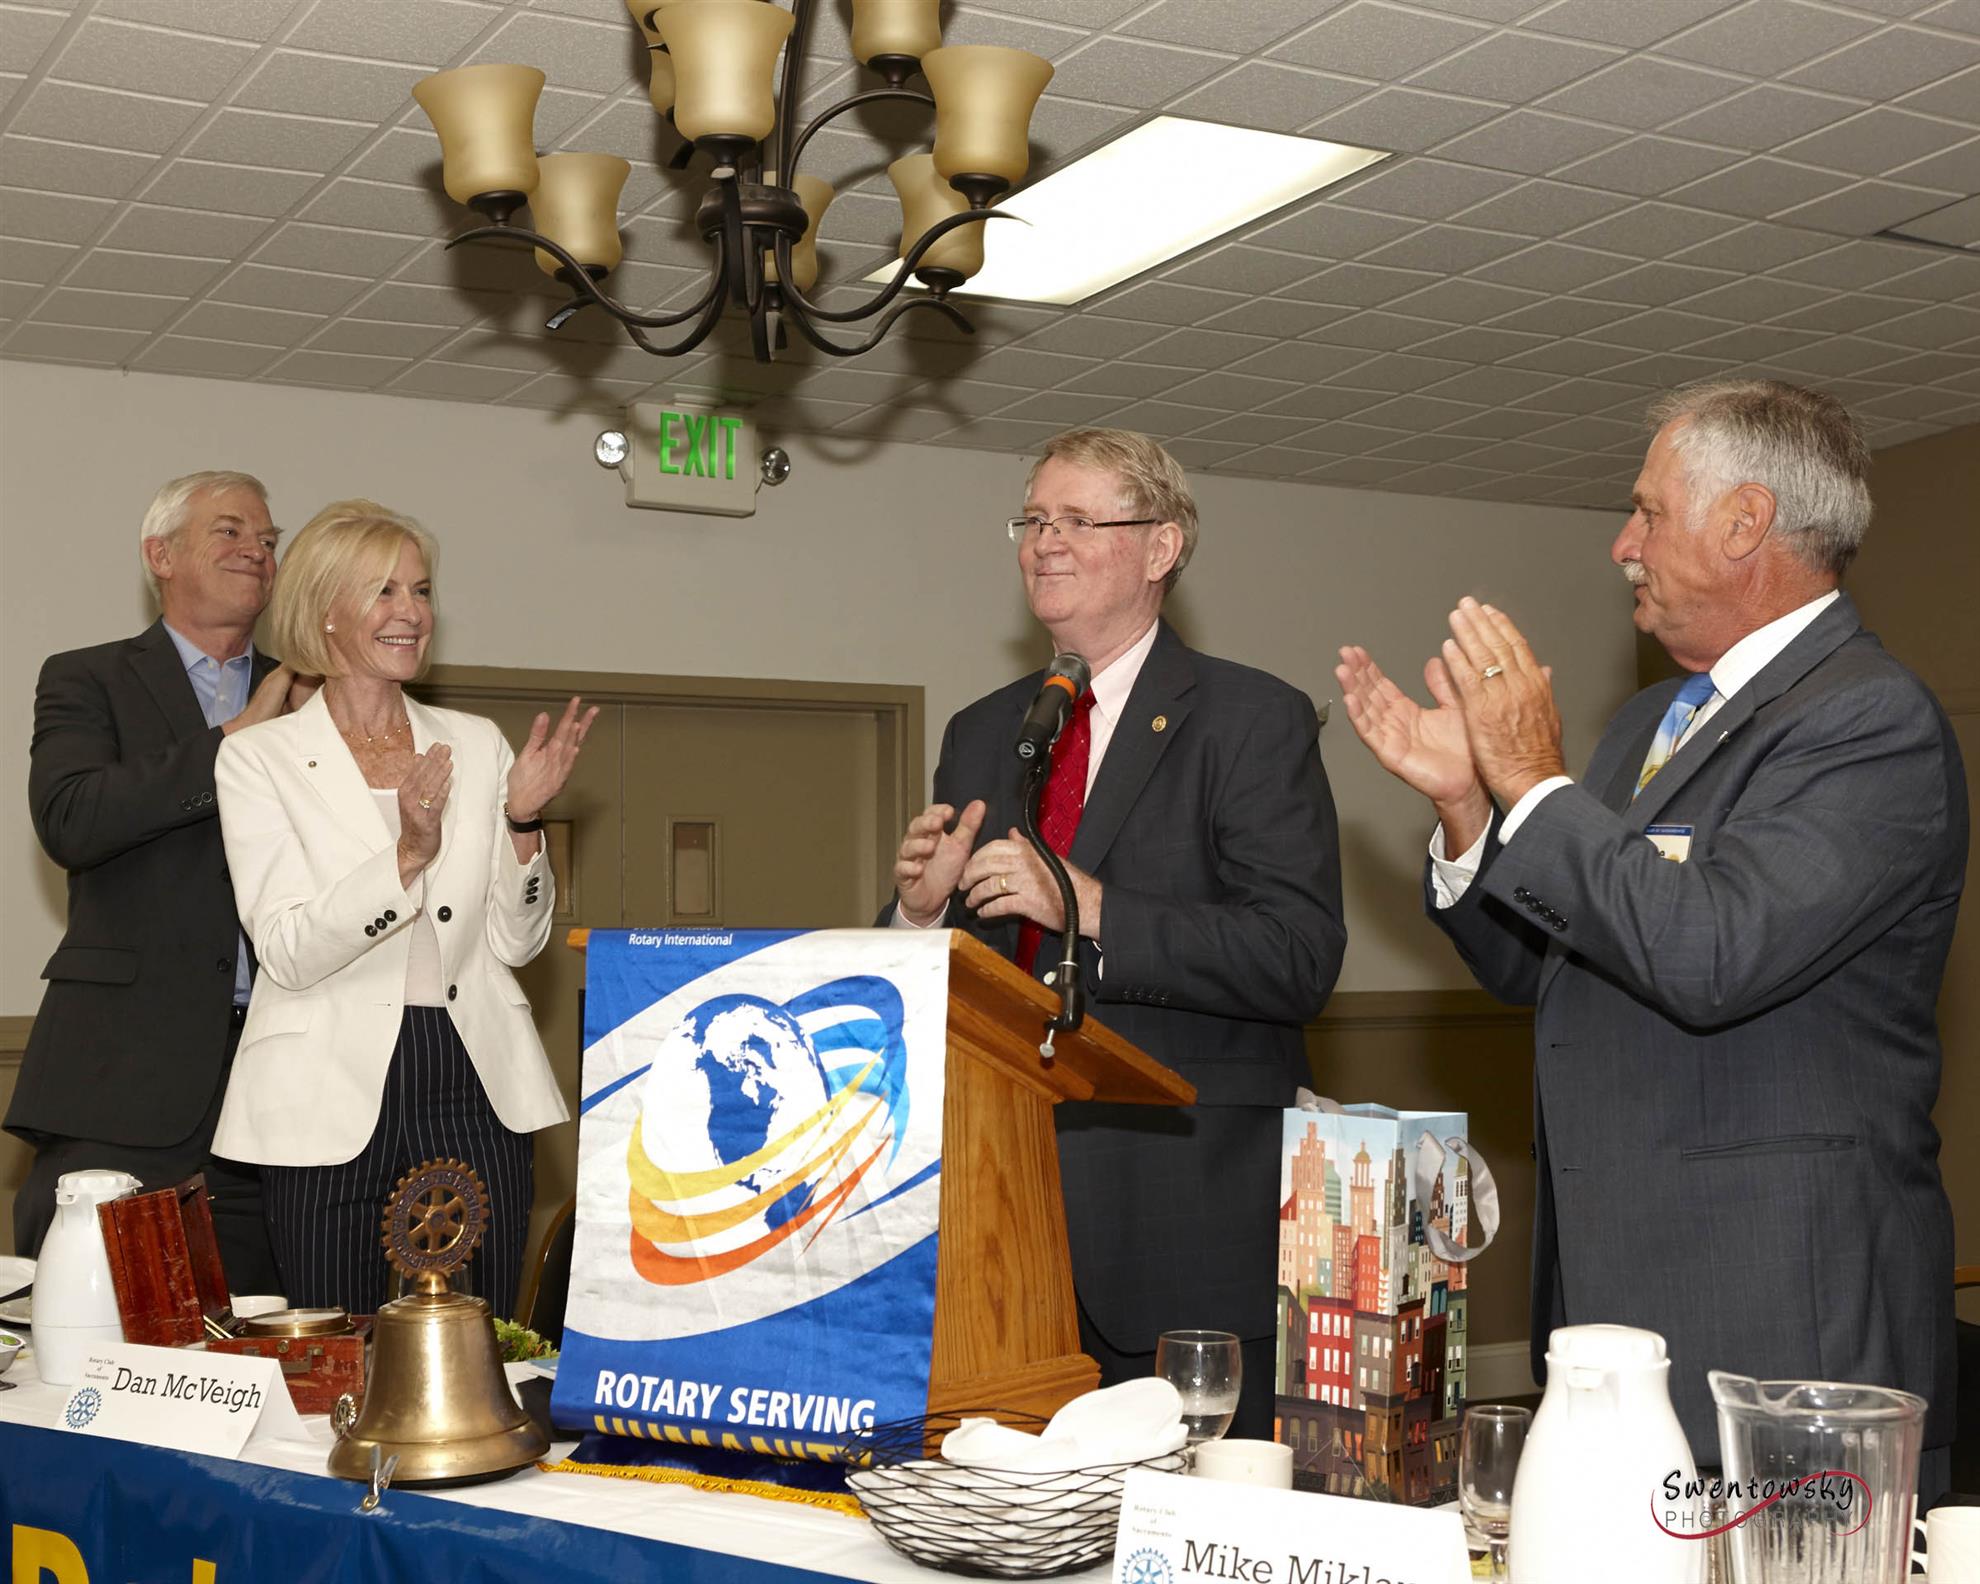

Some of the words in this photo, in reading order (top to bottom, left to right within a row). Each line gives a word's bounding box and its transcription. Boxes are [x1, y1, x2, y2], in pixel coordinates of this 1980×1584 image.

[660, 411, 743, 480] EXIT
[628, 933, 663, 948] Rotary
[664, 933, 733, 946] International
[112, 1367, 157, 1396] Dan
[160, 1373, 262, 1413] McVeigh
[595, 1370, 722, 1419] ROTARY
[727, 1387, 876, 1437] SERVING
[1181, 1540, 1273, 1584] Mike
